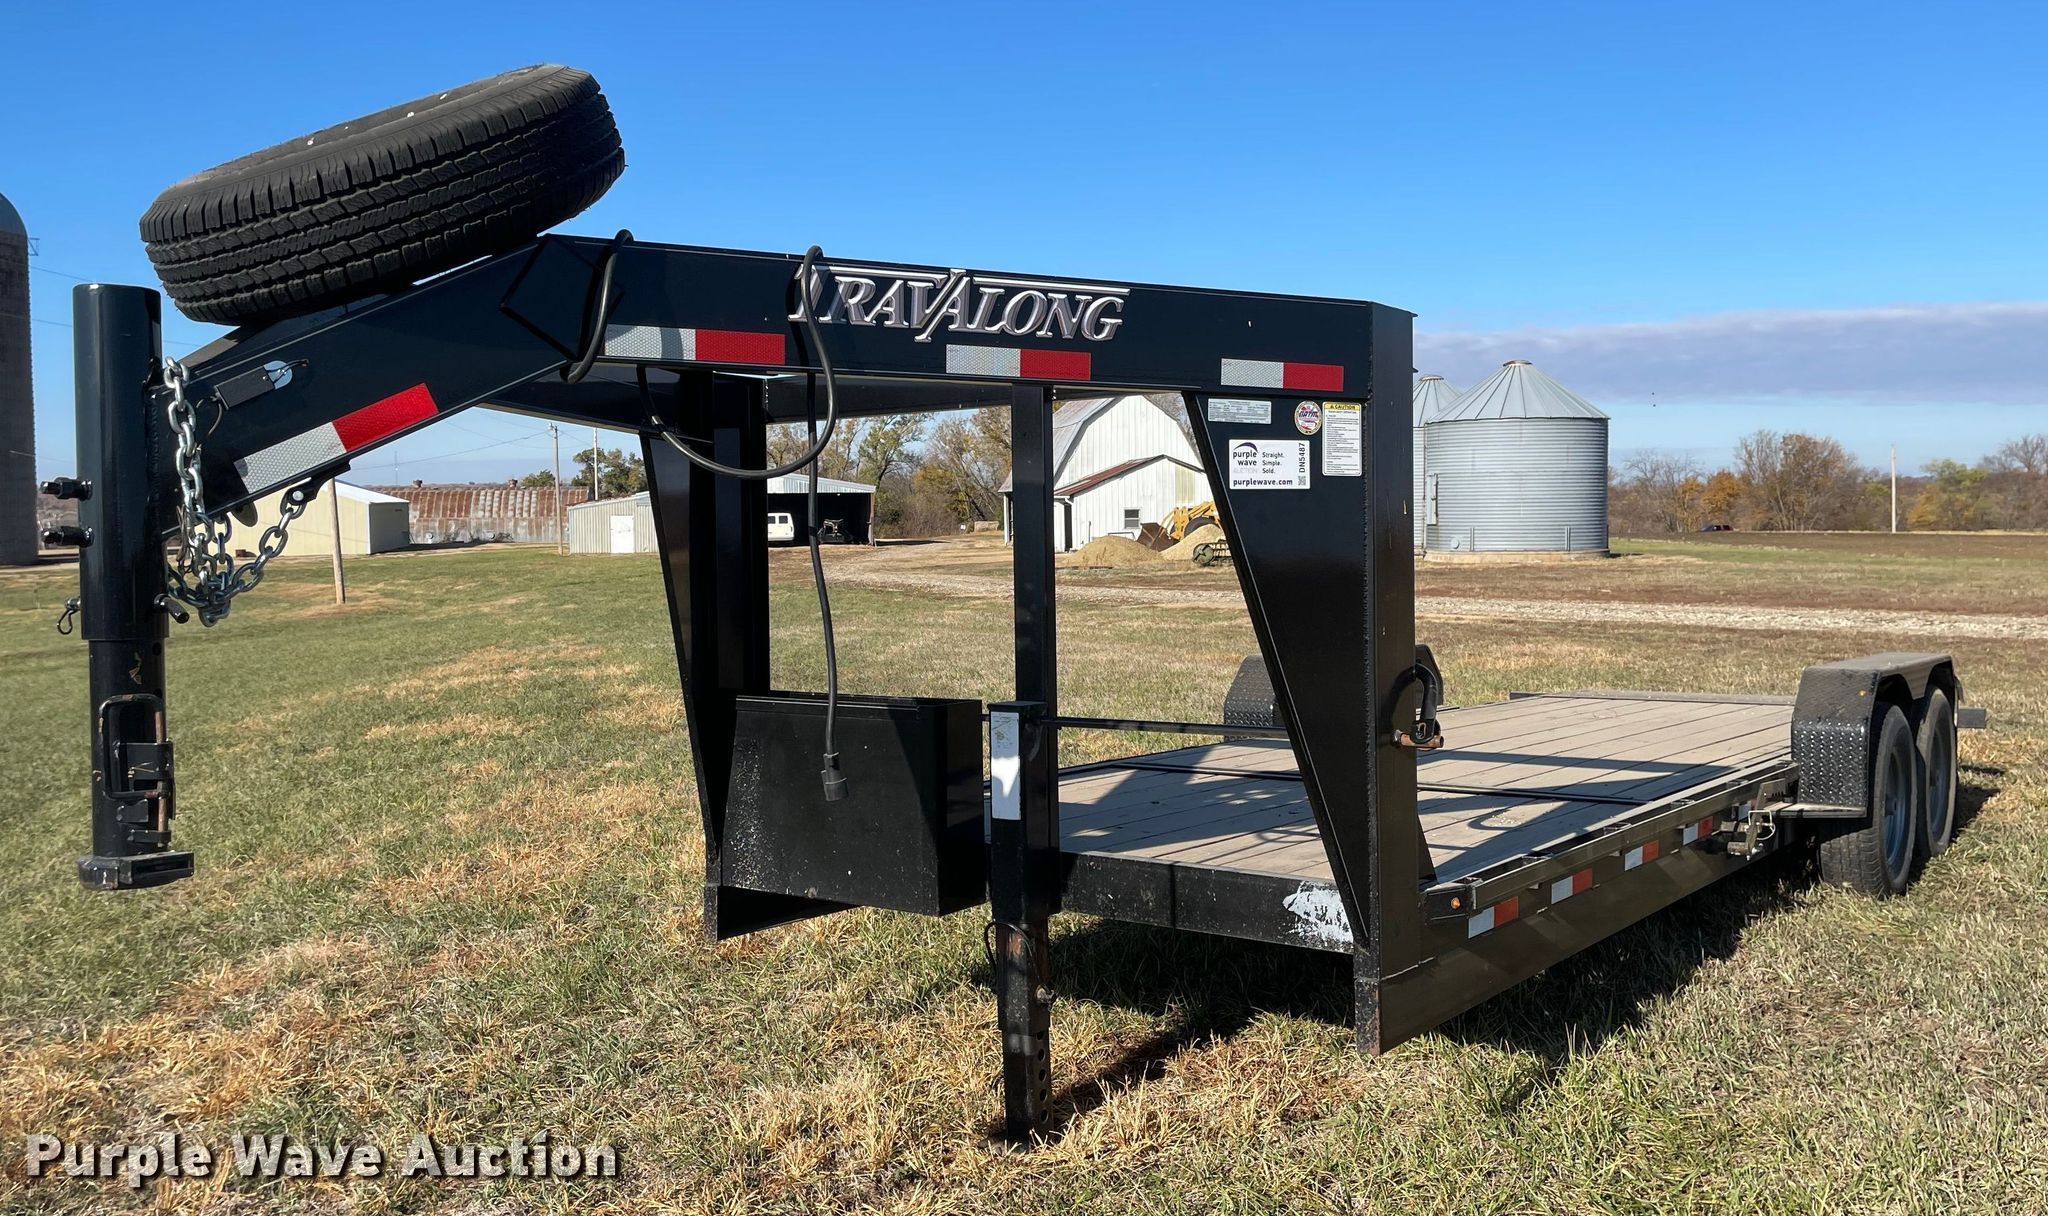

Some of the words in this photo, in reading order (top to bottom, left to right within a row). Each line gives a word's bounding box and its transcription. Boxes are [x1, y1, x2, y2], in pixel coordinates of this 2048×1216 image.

[787, 263, 1131, 343] TRAVALONG
[1233, 449, 1257, 459] purple
[1262, 451, 1285, 459] Straight.
[1233, 477, 1293, 487] purplewave.com
